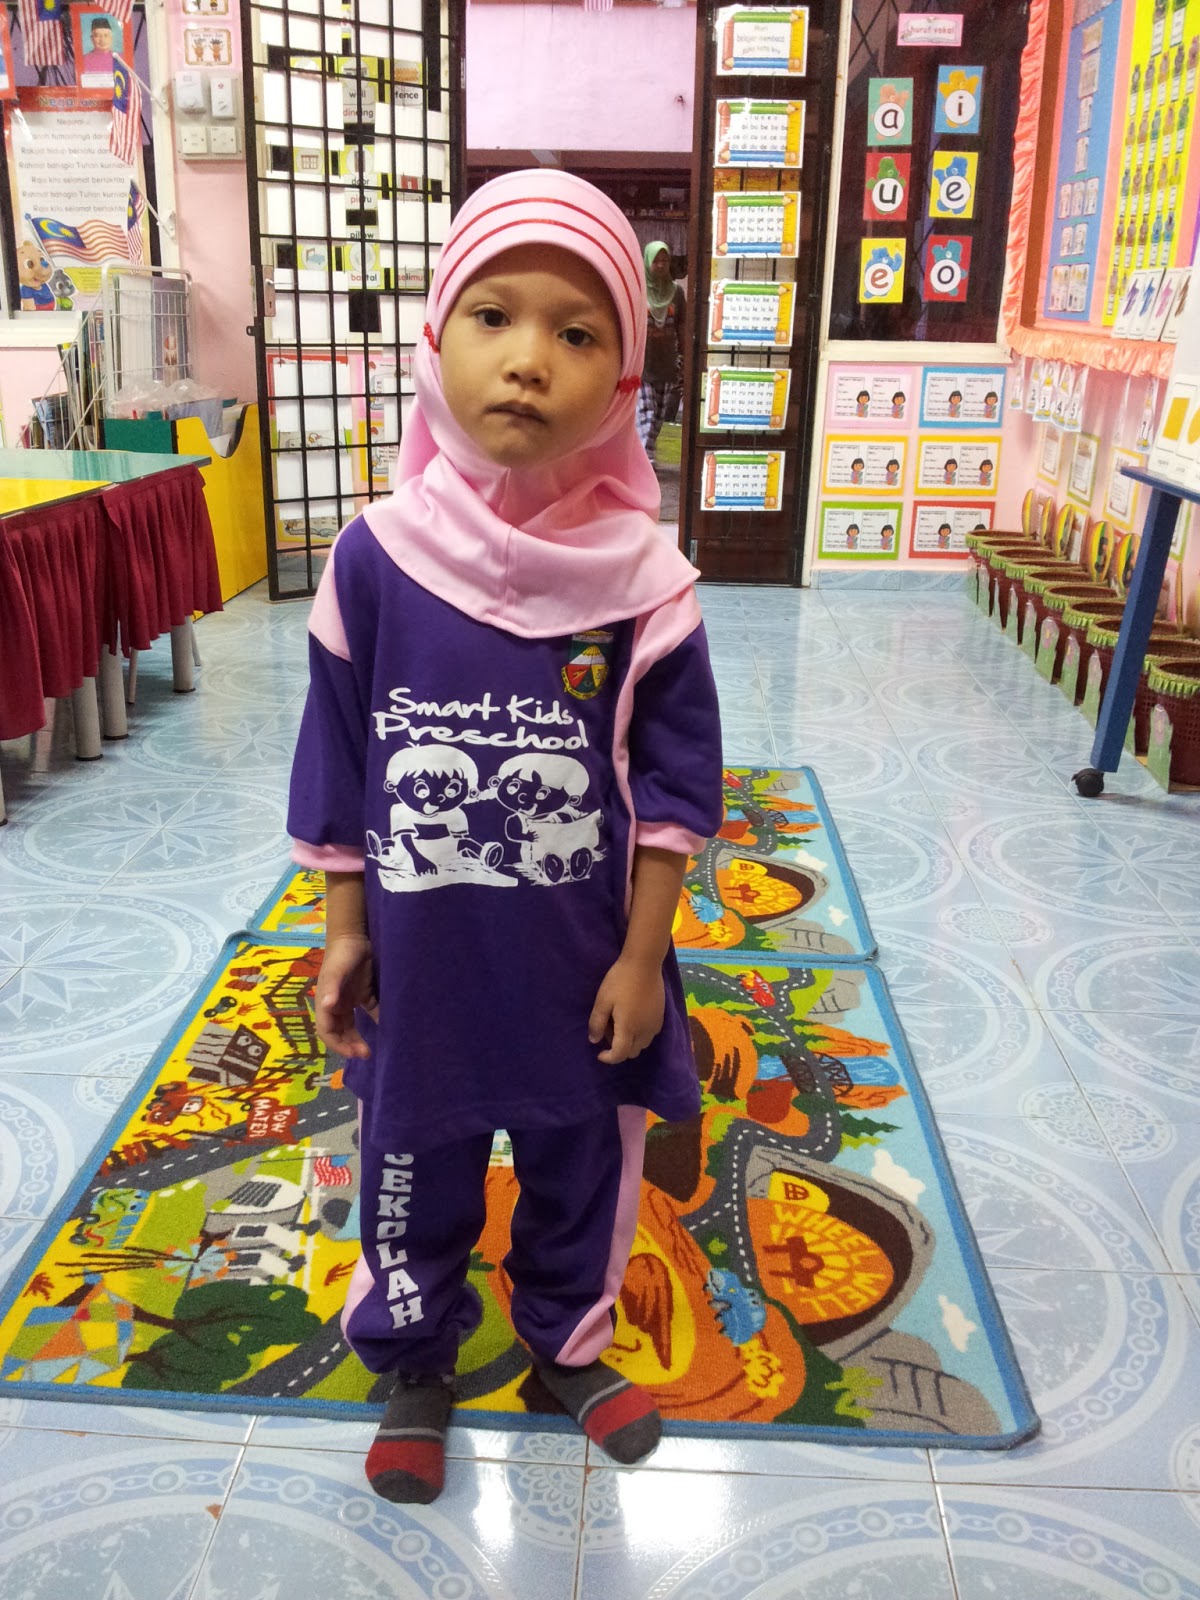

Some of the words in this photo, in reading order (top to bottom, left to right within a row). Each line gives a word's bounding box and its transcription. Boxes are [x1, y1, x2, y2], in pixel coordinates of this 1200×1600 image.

[349, 90, 366, 98] wll
[395, 91, 419, 99] fence
[343, 109, 374, 118] dinng
[957, 95, 963, 116] i
[881, 109, 899, 129] a
[351, 195, 372, 205] pitu
[879, 183, 898, 204] u
[946, 181, 964, 202] e
[350, 231, 374, 239] pilow
[351, 274, 378, 282] batal
[397, 273, 424, 282] selimu
[871, 268, 889, 289] e
[937, 265, 955, 285] o
[389, 687, 501, 720] Smart
[506, 695, 574, 725] Kids
[372, 711, 589, 750] Preschool
[249, 1099, 272, 1138] MATER
[271, 1109, 291, 1133] TOW
